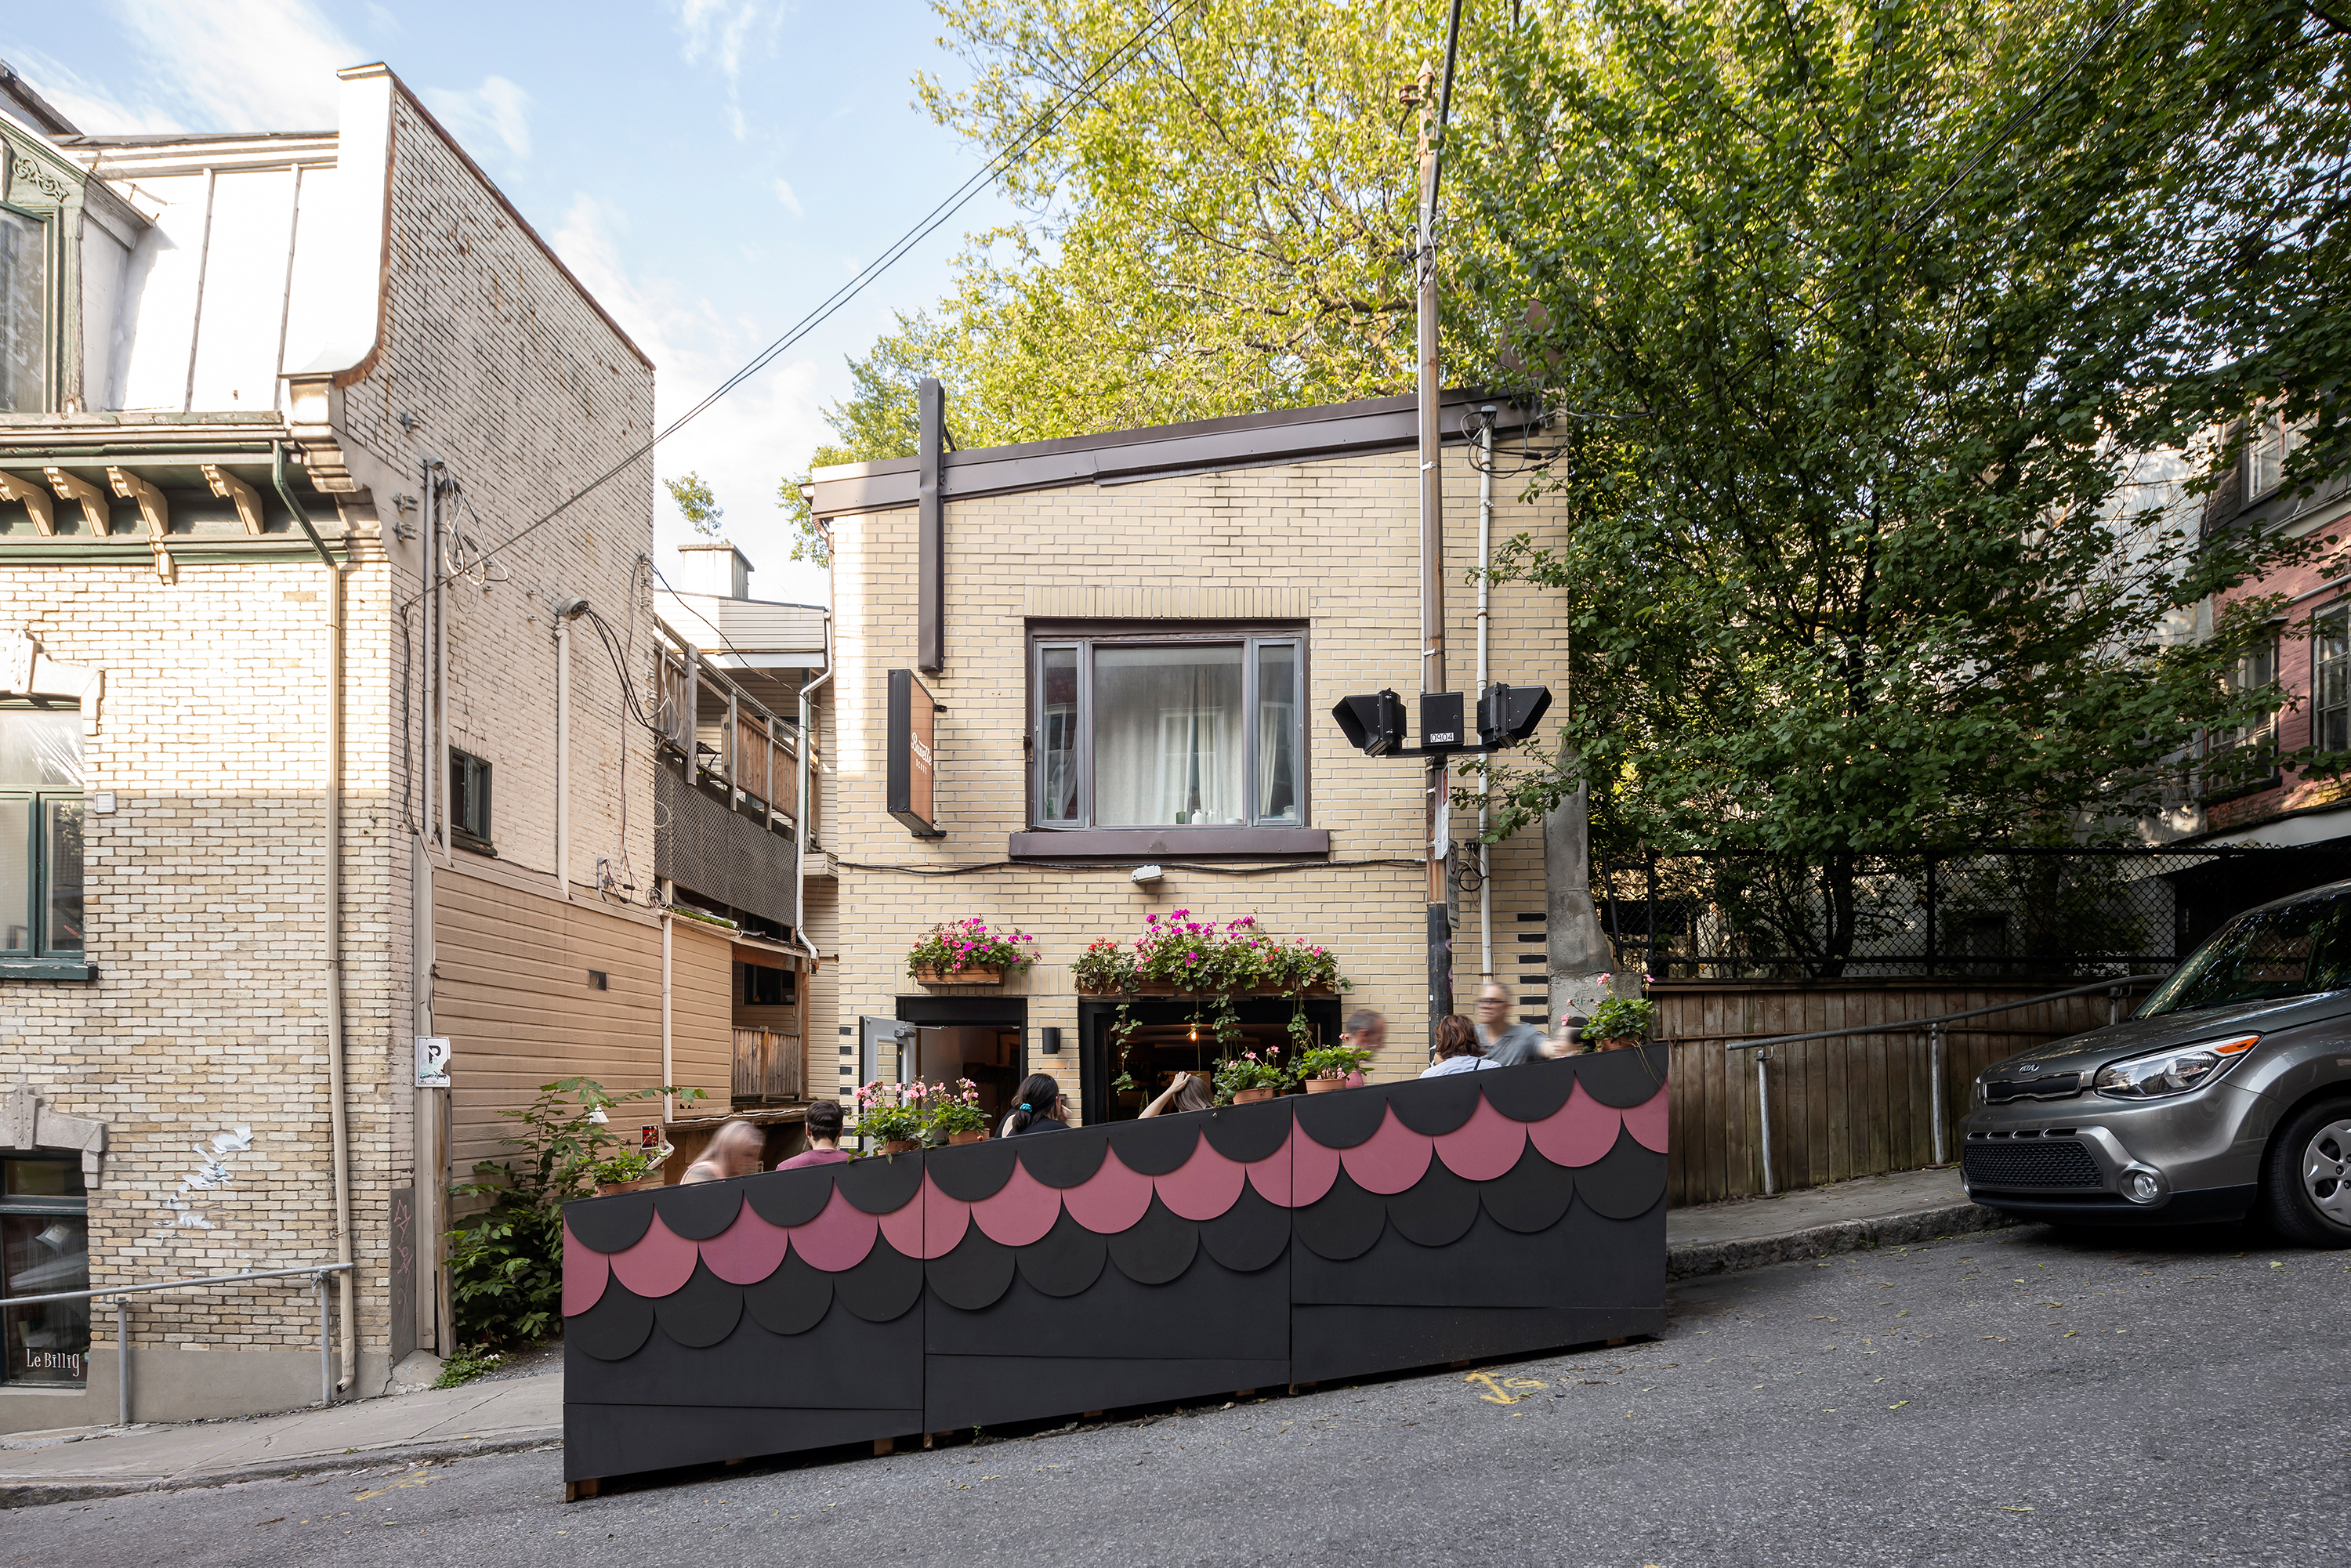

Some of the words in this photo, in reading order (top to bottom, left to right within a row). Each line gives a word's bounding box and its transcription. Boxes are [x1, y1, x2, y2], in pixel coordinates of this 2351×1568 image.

[1431, 733, 1453, 742] 0904
[911, 731, 932, 766] Buvette
[428, 1045, 442, 1064] P
[2020, 1063, 2038, 1073] KIA
[27, 1348, 42, 1367] Le
[44, 1352, 80, 1377] Billig
